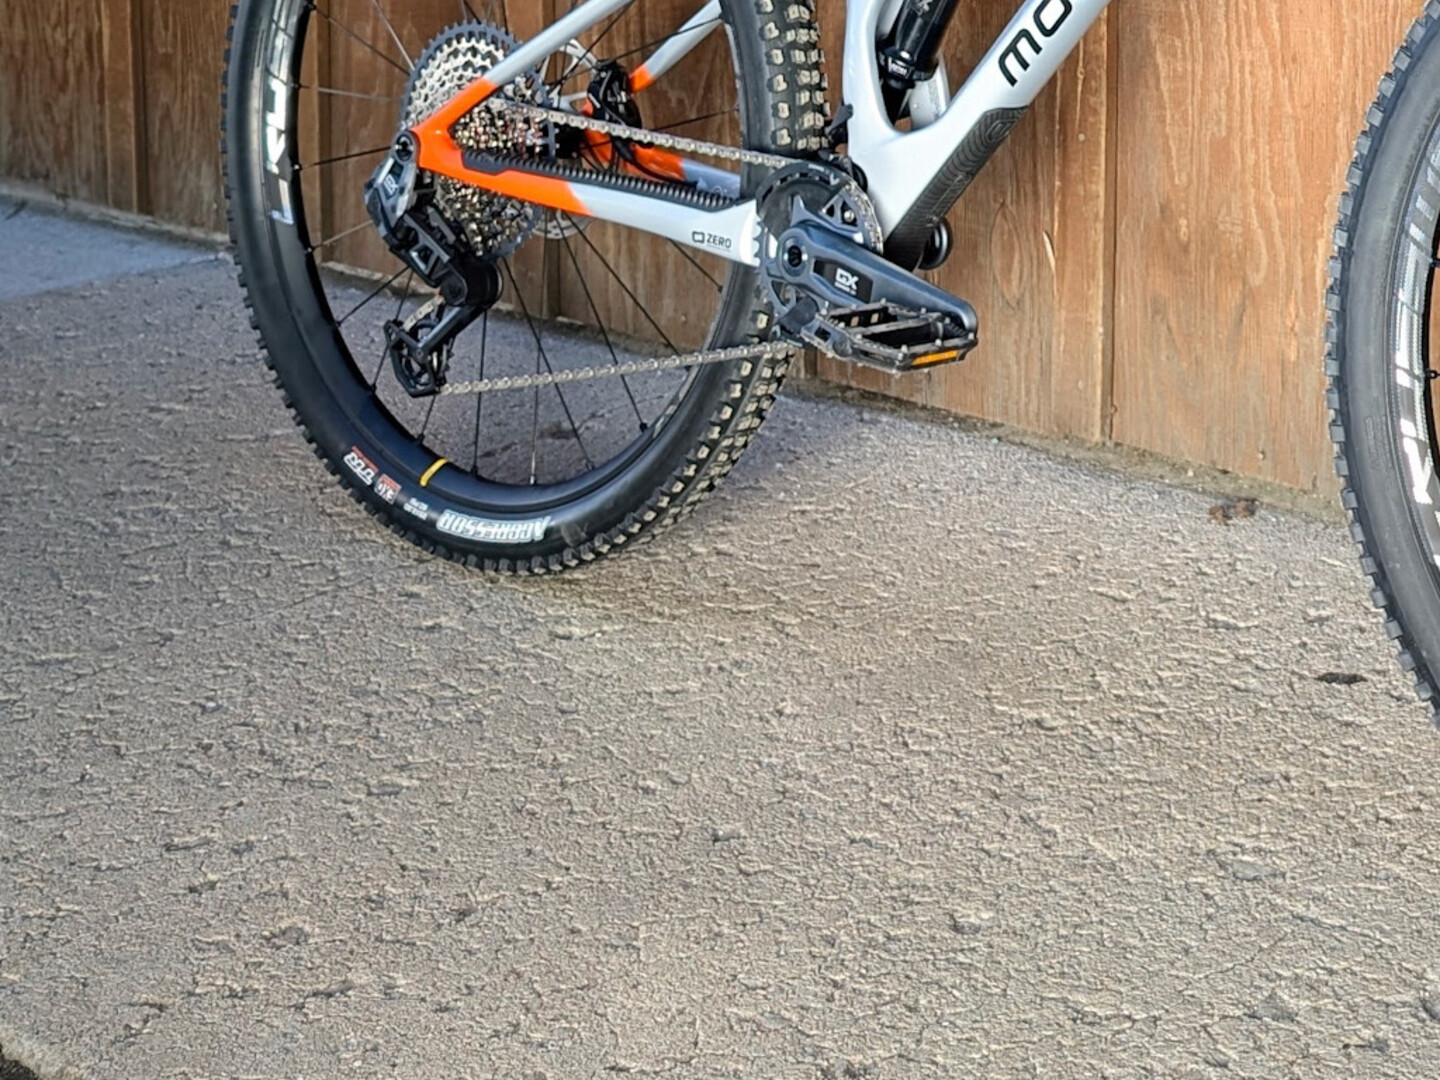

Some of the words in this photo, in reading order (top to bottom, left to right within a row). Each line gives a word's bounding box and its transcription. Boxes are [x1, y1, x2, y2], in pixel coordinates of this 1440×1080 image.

[706, 233, 732, 249] ZERO
[836, 267, 860, 289] GX
[436, 509, 553, 543] AGGRESSOR
